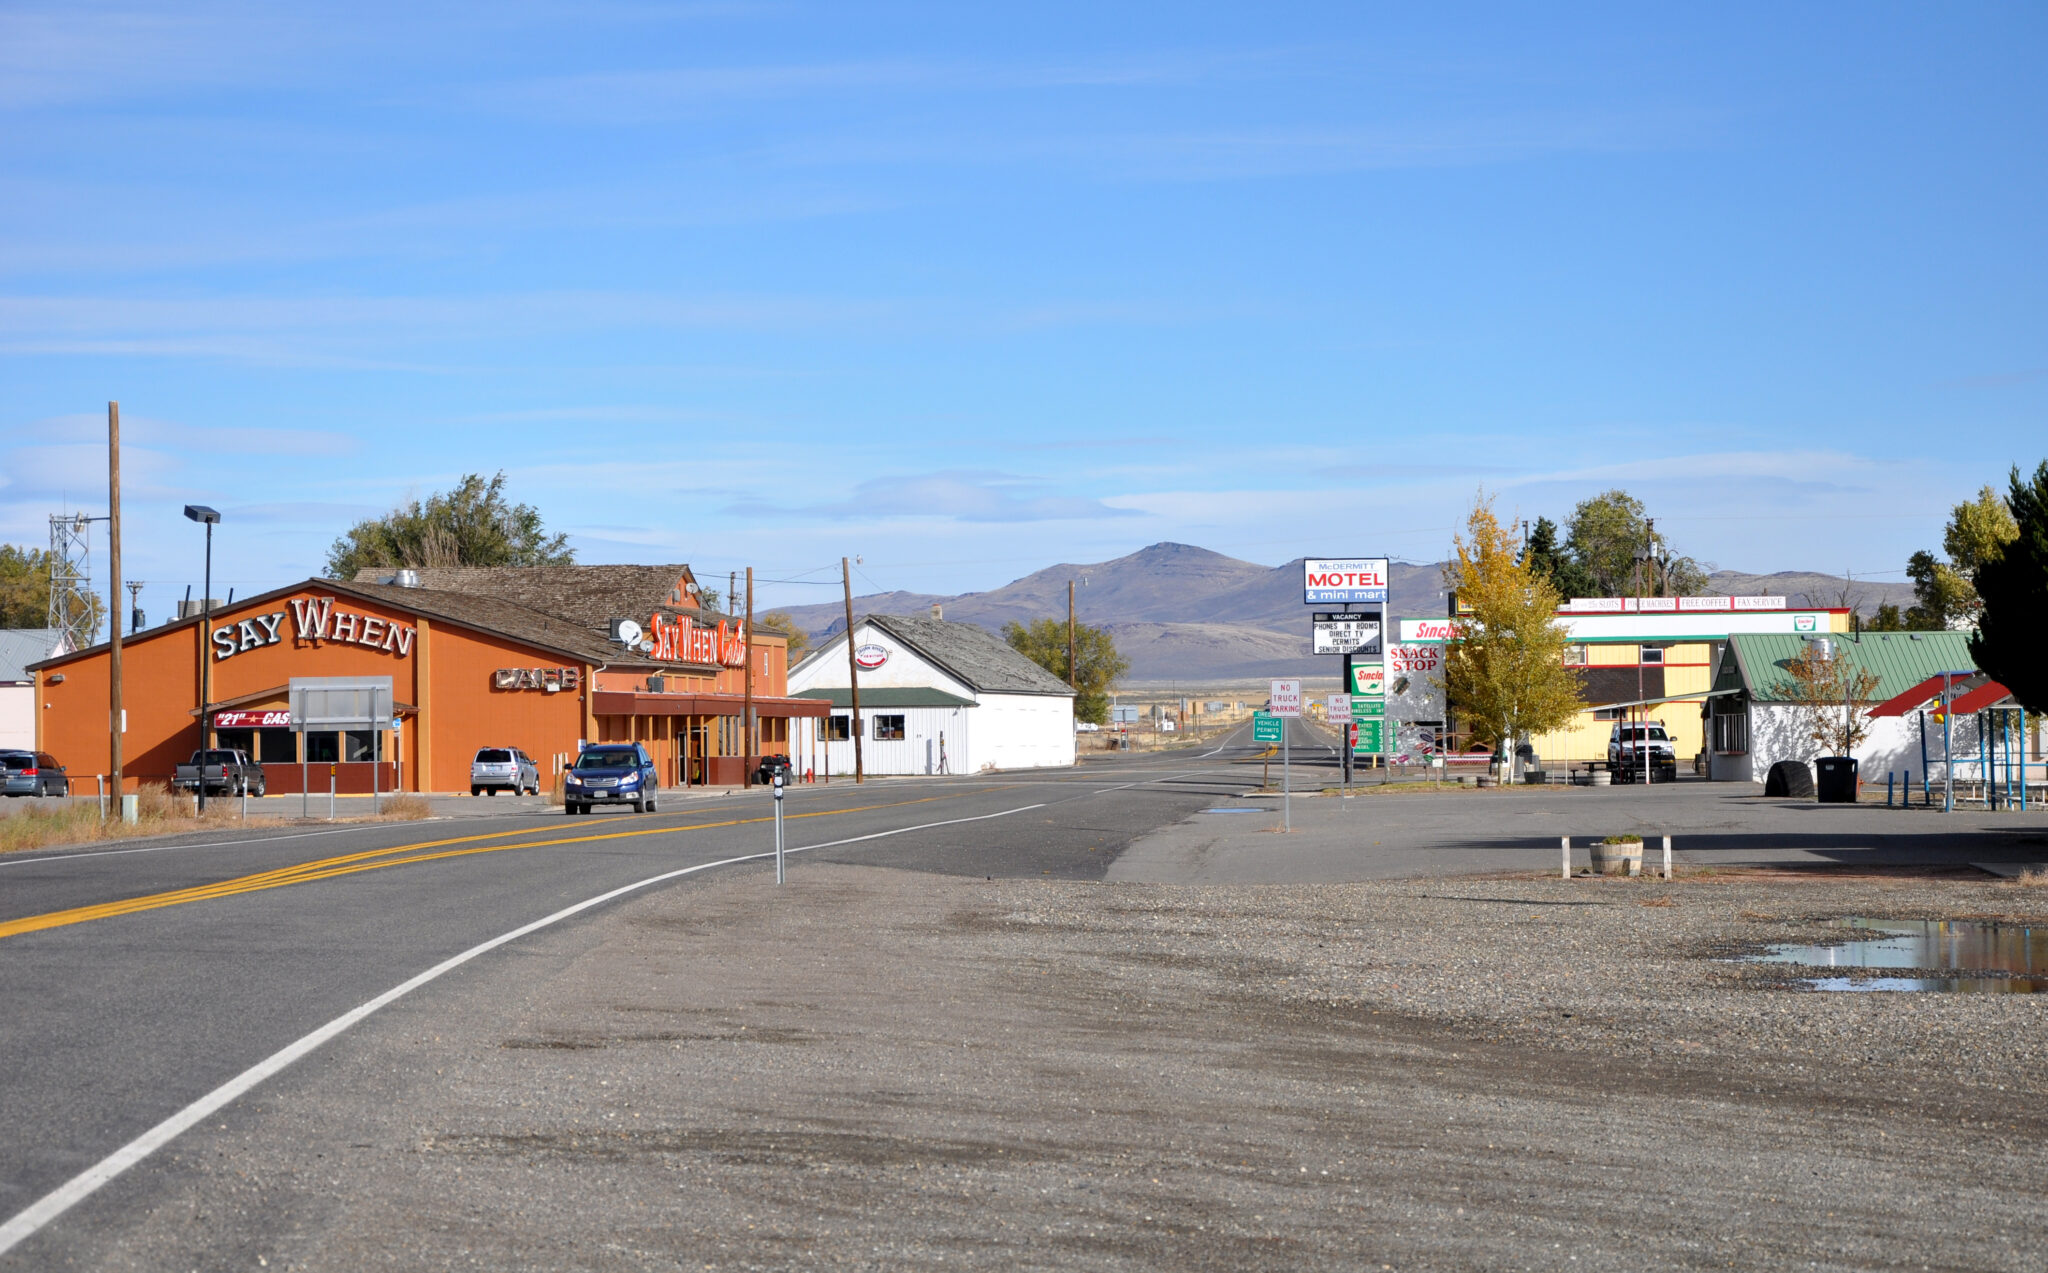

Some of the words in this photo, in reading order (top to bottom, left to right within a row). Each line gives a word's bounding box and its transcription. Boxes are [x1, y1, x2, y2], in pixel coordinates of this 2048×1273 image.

[1308, 573, 1384, 586] MOTEL
[1307, 590, 1316, 600] &
[1321, 590, 1348, 599] mini
[1355, 590, 1386, 599] mart
[1599, 600, 1619, 608] SLOTS
[1682, 599, 1700, 607] FREE
[1701, 599, 1728, 607] COFFEE
[1738, 598, 1751, 607] FAX
[1753, 598, 1782, 607] SERVICE
[213, 612, 286, 660] SAY
[291, 597, 417, 657] WHEN
[1390, 648, 1439, 659] SNACK
[1393, 660, 1437, 671] STOP
[496, 667, 579, 688] CAFE
[1358, 670, 1383, 680] Sincla
[1271, 705, 1300, 713] PARKING
[217, 713, 247, 726] "21"
[262, 712, 290, 725] CAS
